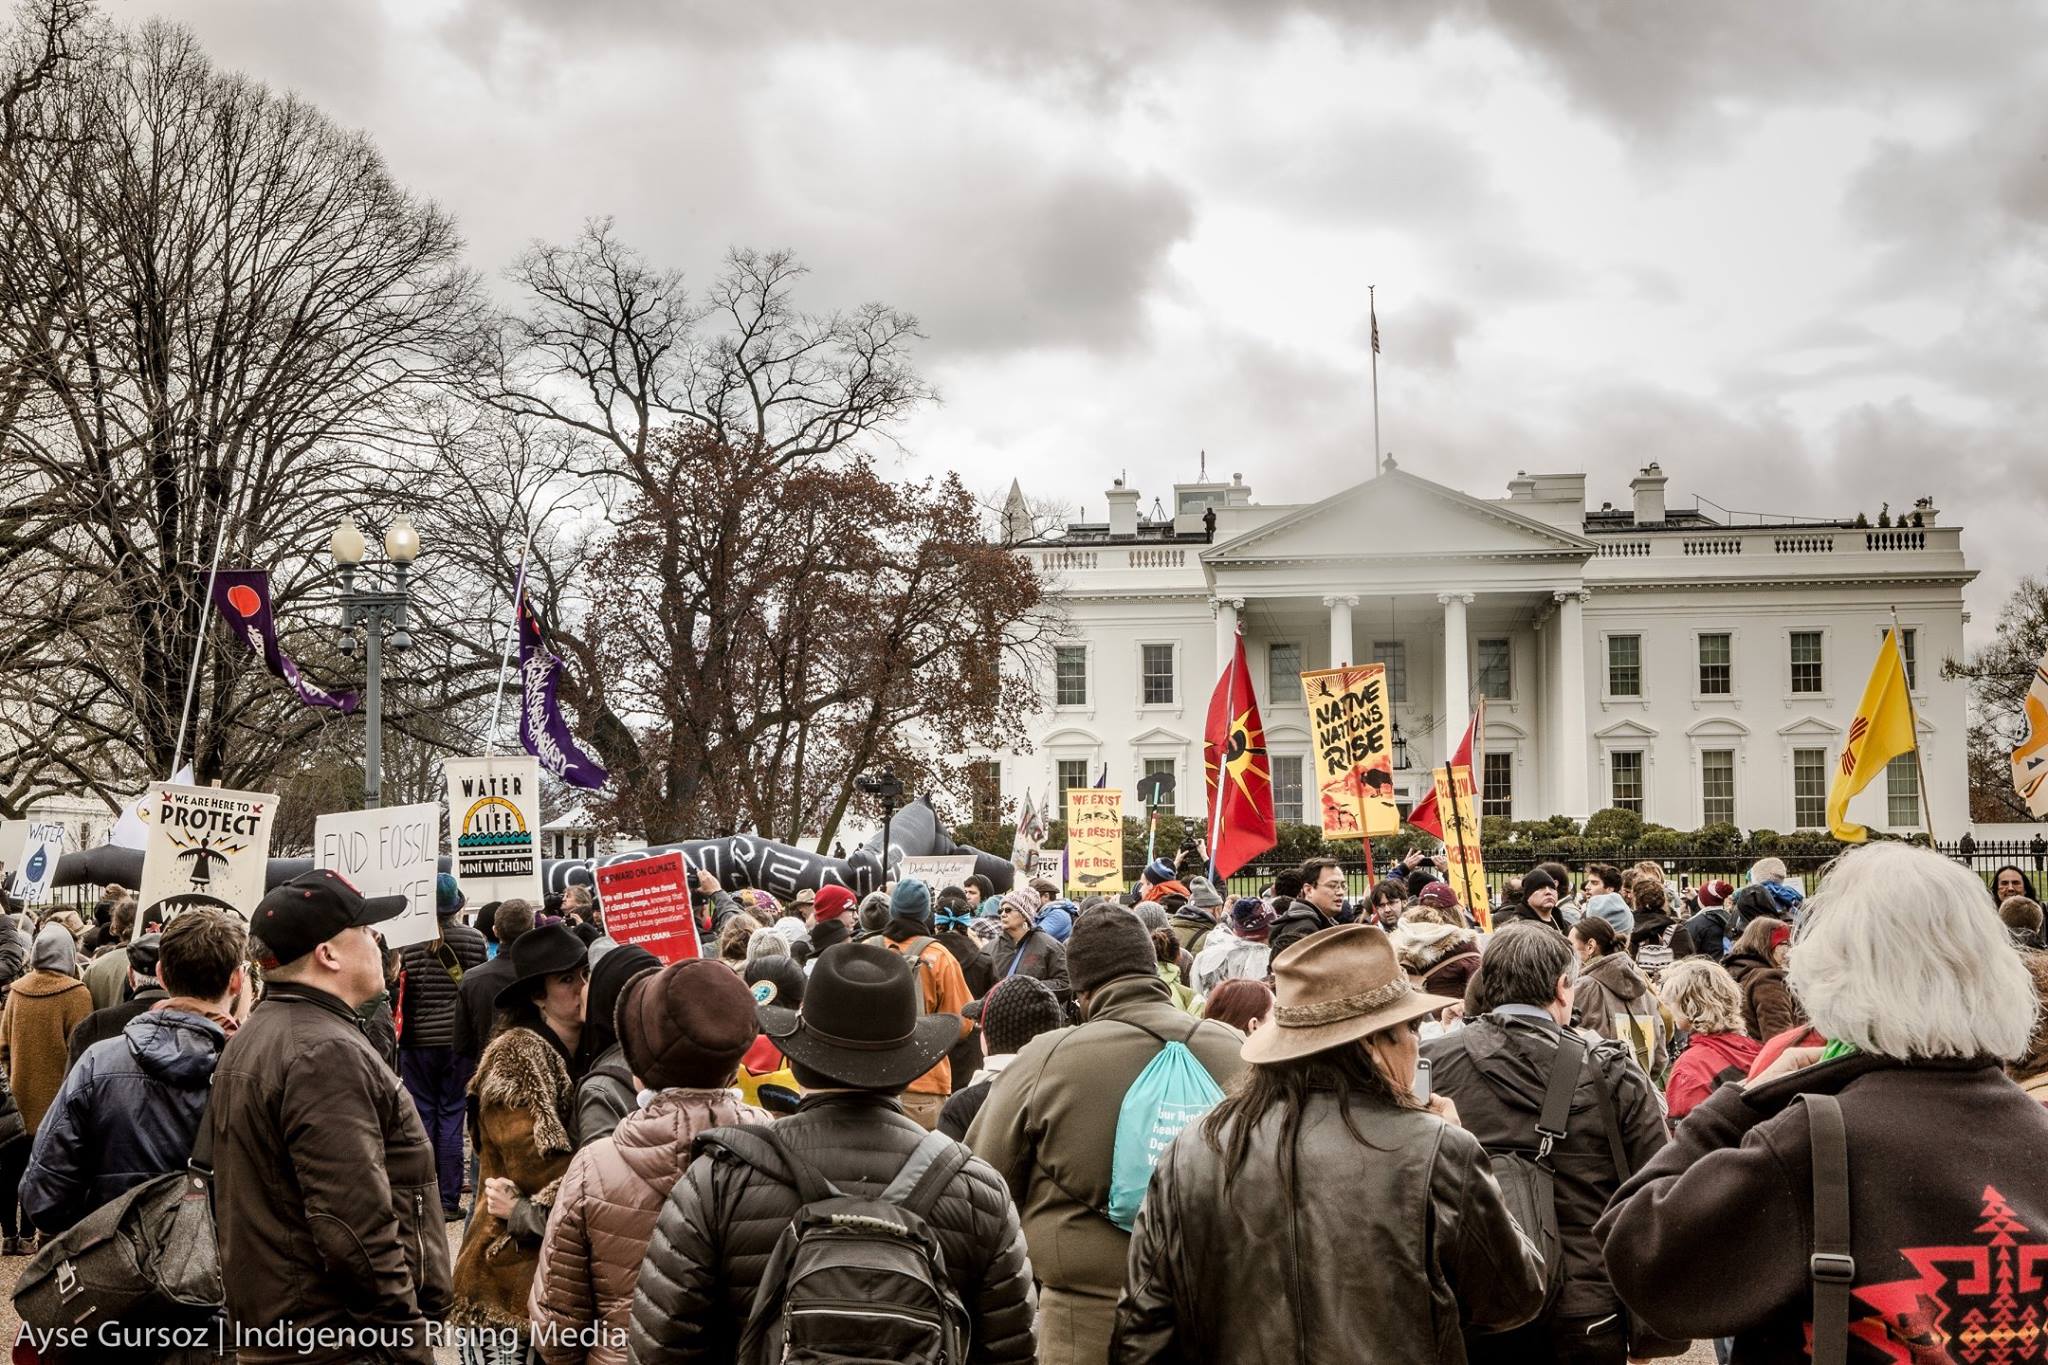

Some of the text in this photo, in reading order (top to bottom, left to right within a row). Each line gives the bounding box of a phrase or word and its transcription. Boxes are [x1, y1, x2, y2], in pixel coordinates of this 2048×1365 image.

[1316, 680, 1380, 729] NATIVE
[1320, 704, 1383, 749] NATIONS
[1323, 724, 1384, 775] RISE
[461, 777, 522, 797] WATER
[174, 794, 250, 813] WE ARE HERE TO
[1072, 794, 1121, 806] WE EXIST
[160, 804, 260, 836] PROTECT
[475, 813, 512, 832] LIFE
[29, 822, 65, 845] WATER
[1069, 827, 1121, 838] WE RESIST
[323, 823, 434, 874] END FOSSIL
[635, 869, 647, 878] ON
[648, 862, 676, 874] CLIMATE
[1074, 857, 1116, 869] WE RISE
[629, 931, 672, 944] BARACK OBAMA
